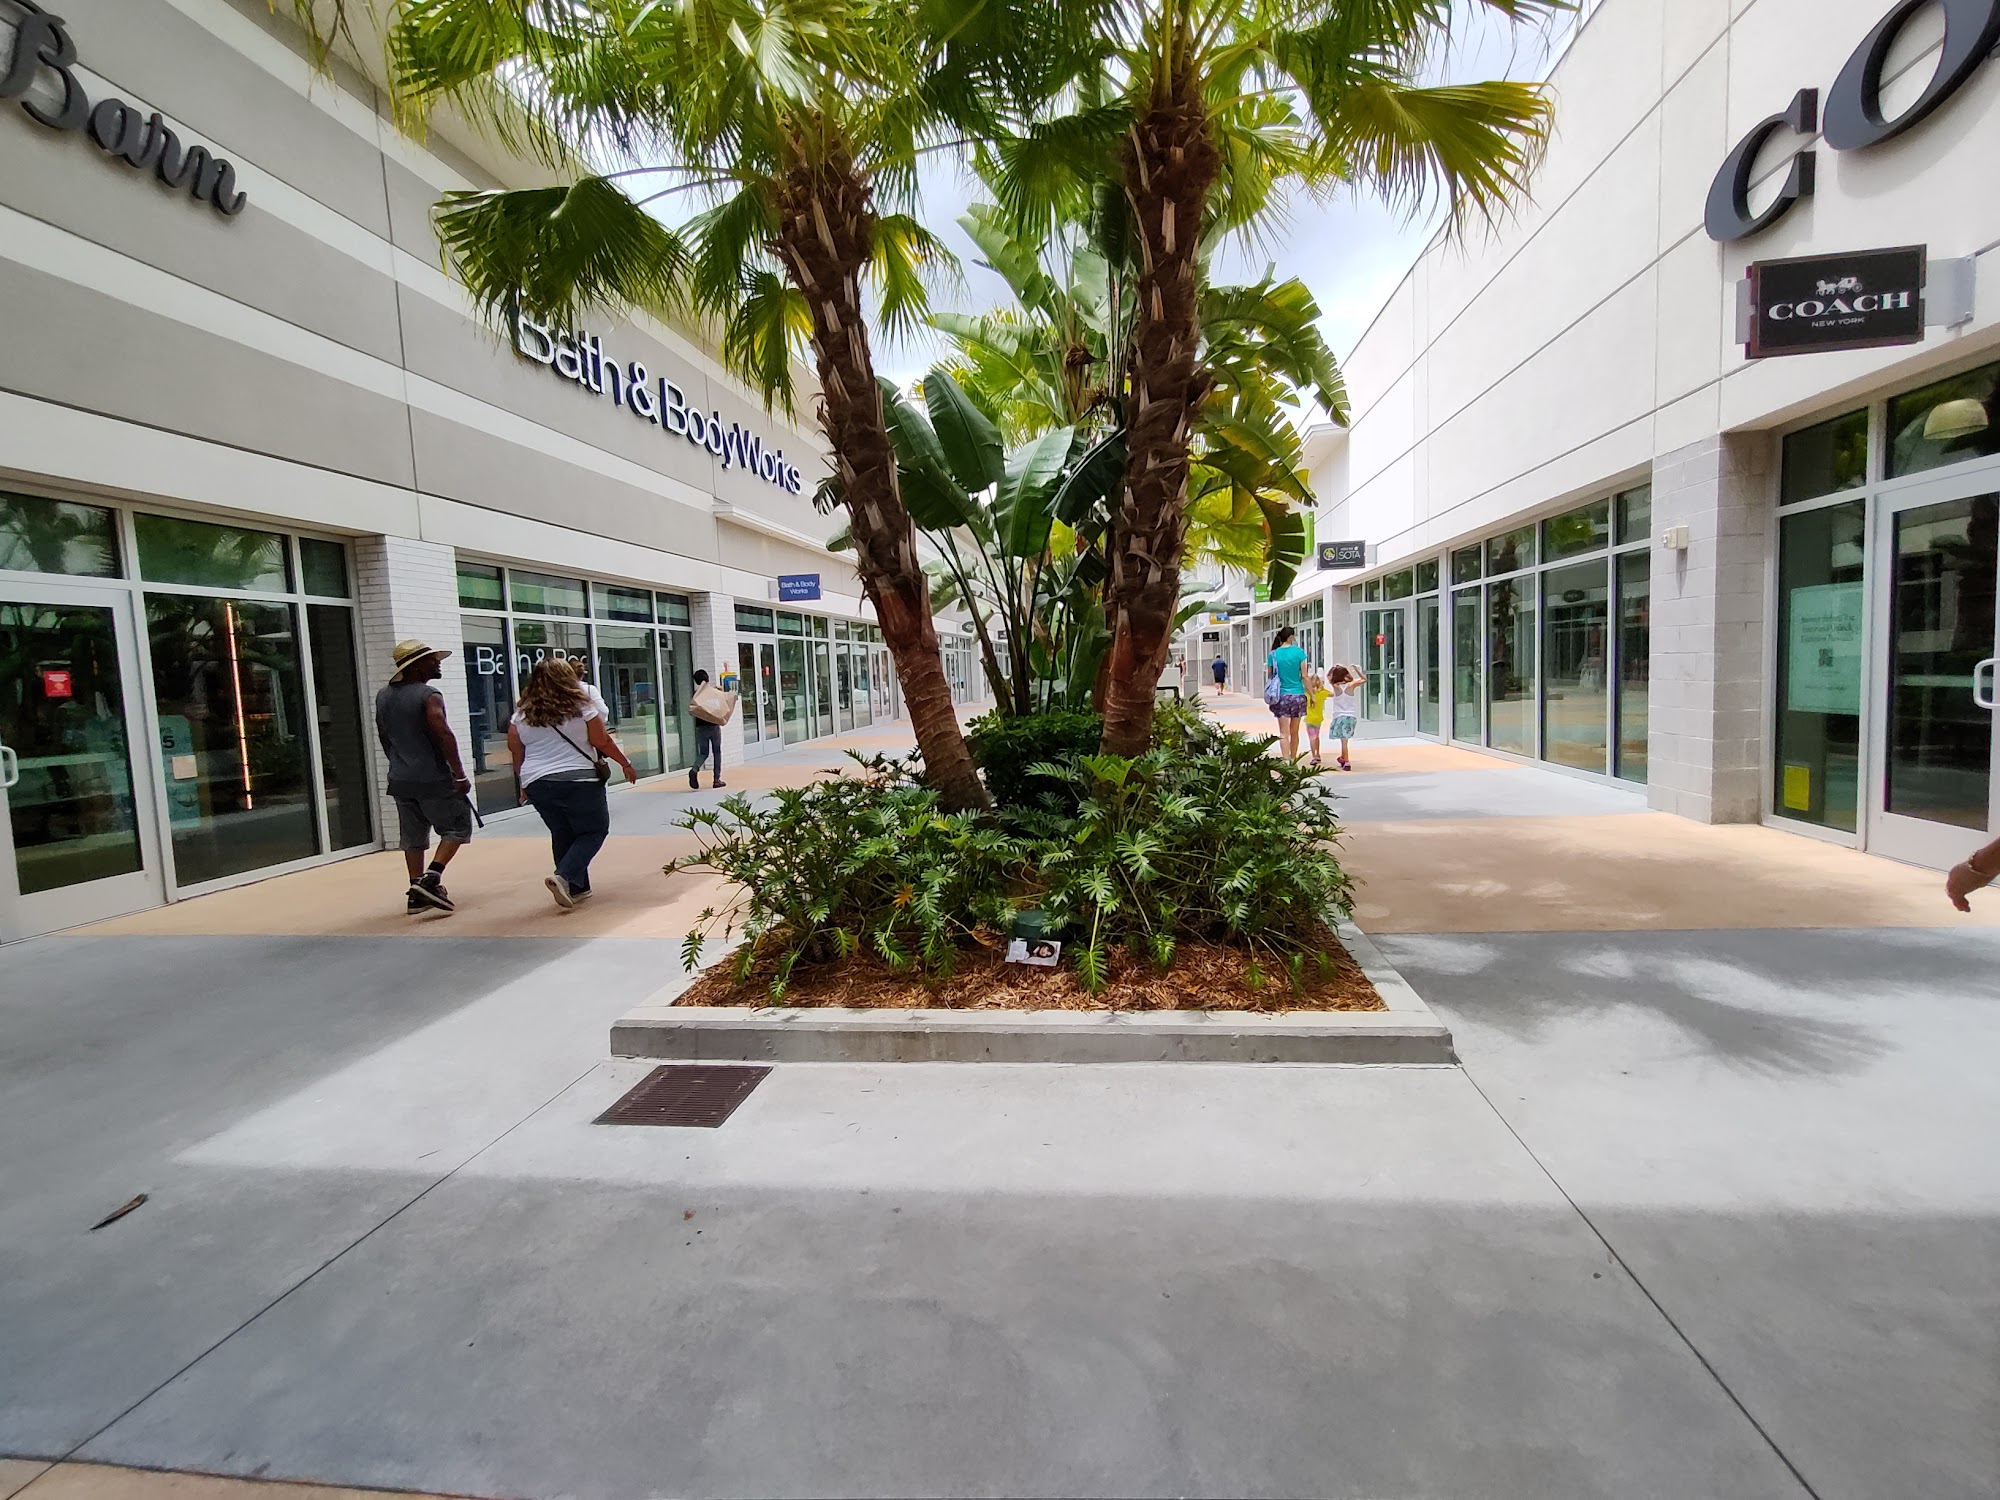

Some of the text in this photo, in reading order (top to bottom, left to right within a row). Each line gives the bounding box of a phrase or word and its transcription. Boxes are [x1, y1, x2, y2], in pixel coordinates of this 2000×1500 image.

[0, 0, 247, 215] Barn
[1768, 291, 1910, 321] COACH
[1811, 316, 1866, 328] NEW YORK
[626, 361, 659, 425] &
[1338, 550, 1361, 560] SOTA
[800, 580, 816, 588] Body
[476, 646, 532, 675] Bah
